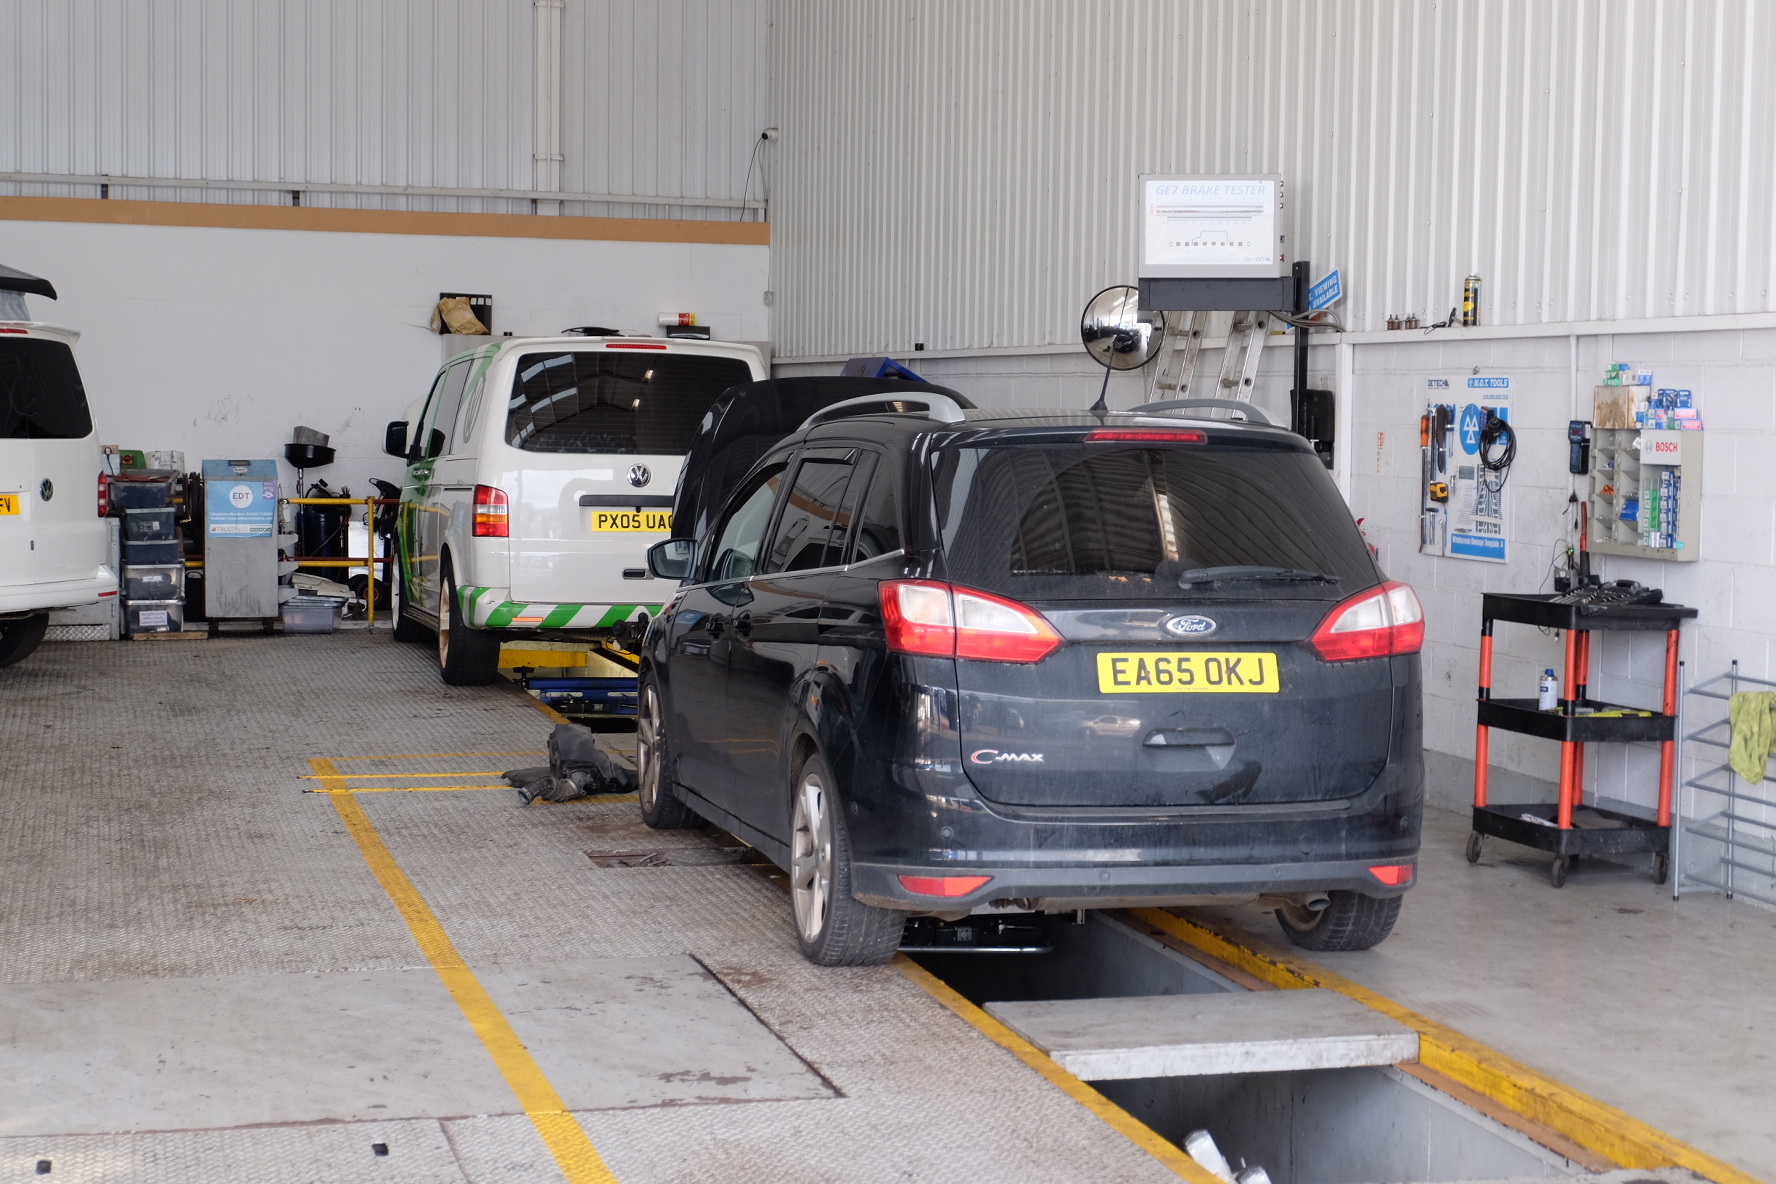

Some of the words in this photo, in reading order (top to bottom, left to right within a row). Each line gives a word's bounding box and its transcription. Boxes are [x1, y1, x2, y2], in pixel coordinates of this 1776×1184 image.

[1156, 185, 1179, 195] GE7
[1182, 185, 1220, 195] BRAKE
[1225, 185, 1266, 195] TESTER
[1314, 275, 1337, 297] VIEWING
[1313, 284, 1338, 308] AVAILABLE
[1490, 378, 1508, 387] TOOLS
[1655, 442, 1678, 452] BOSCH
[232, 492, 250, 500] EDT
[598, 514, 641, 529] PX05
[1178, 619, 1207, 632] Ford
[1111, 657, 1195, 686] EA65
[1204, 657, 1265, 686] OKJ
[970, 749, 1045, 764] C-MAX
